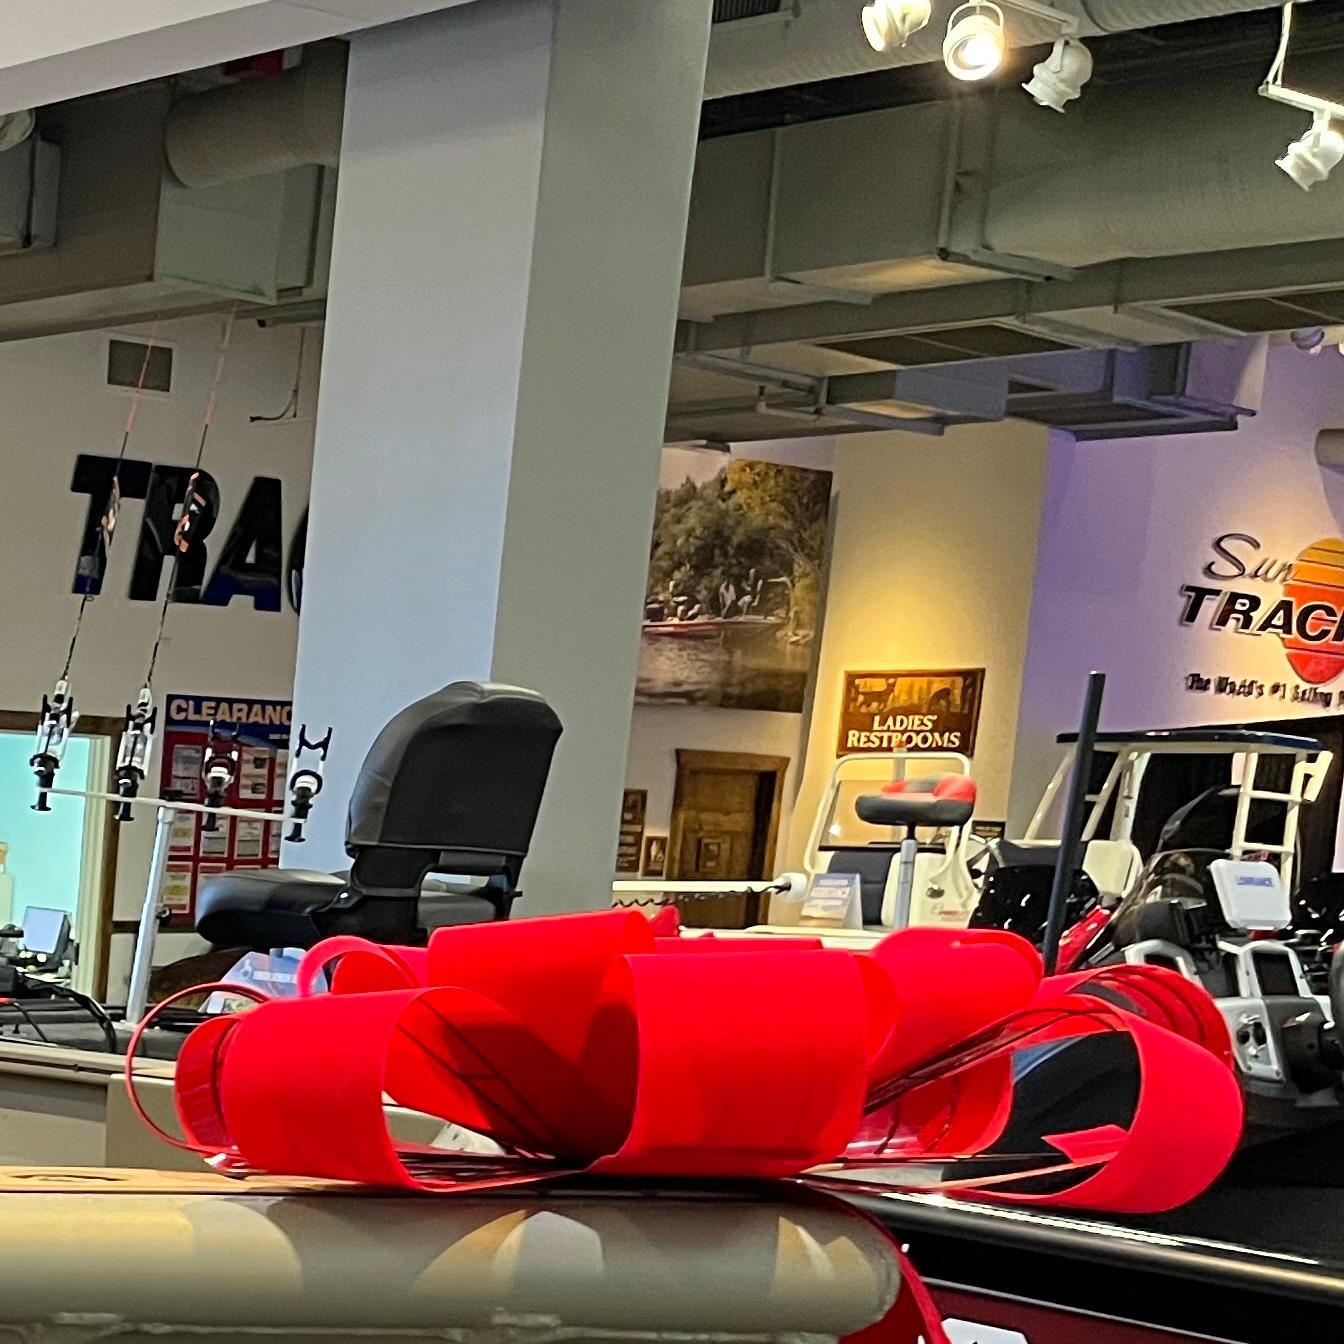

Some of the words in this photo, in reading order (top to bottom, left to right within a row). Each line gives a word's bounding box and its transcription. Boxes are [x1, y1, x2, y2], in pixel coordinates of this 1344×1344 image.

[71, 454, 309, 616] TRA
[1204, 533, 1294, 584] Sun
[1182, 584, 1344, 643] TRAC
[169, 699, 292, 726] CLEARANC
[872, 714, 937, 732] LADIES'
[846, 729, 961, 749] RESTROOMS
